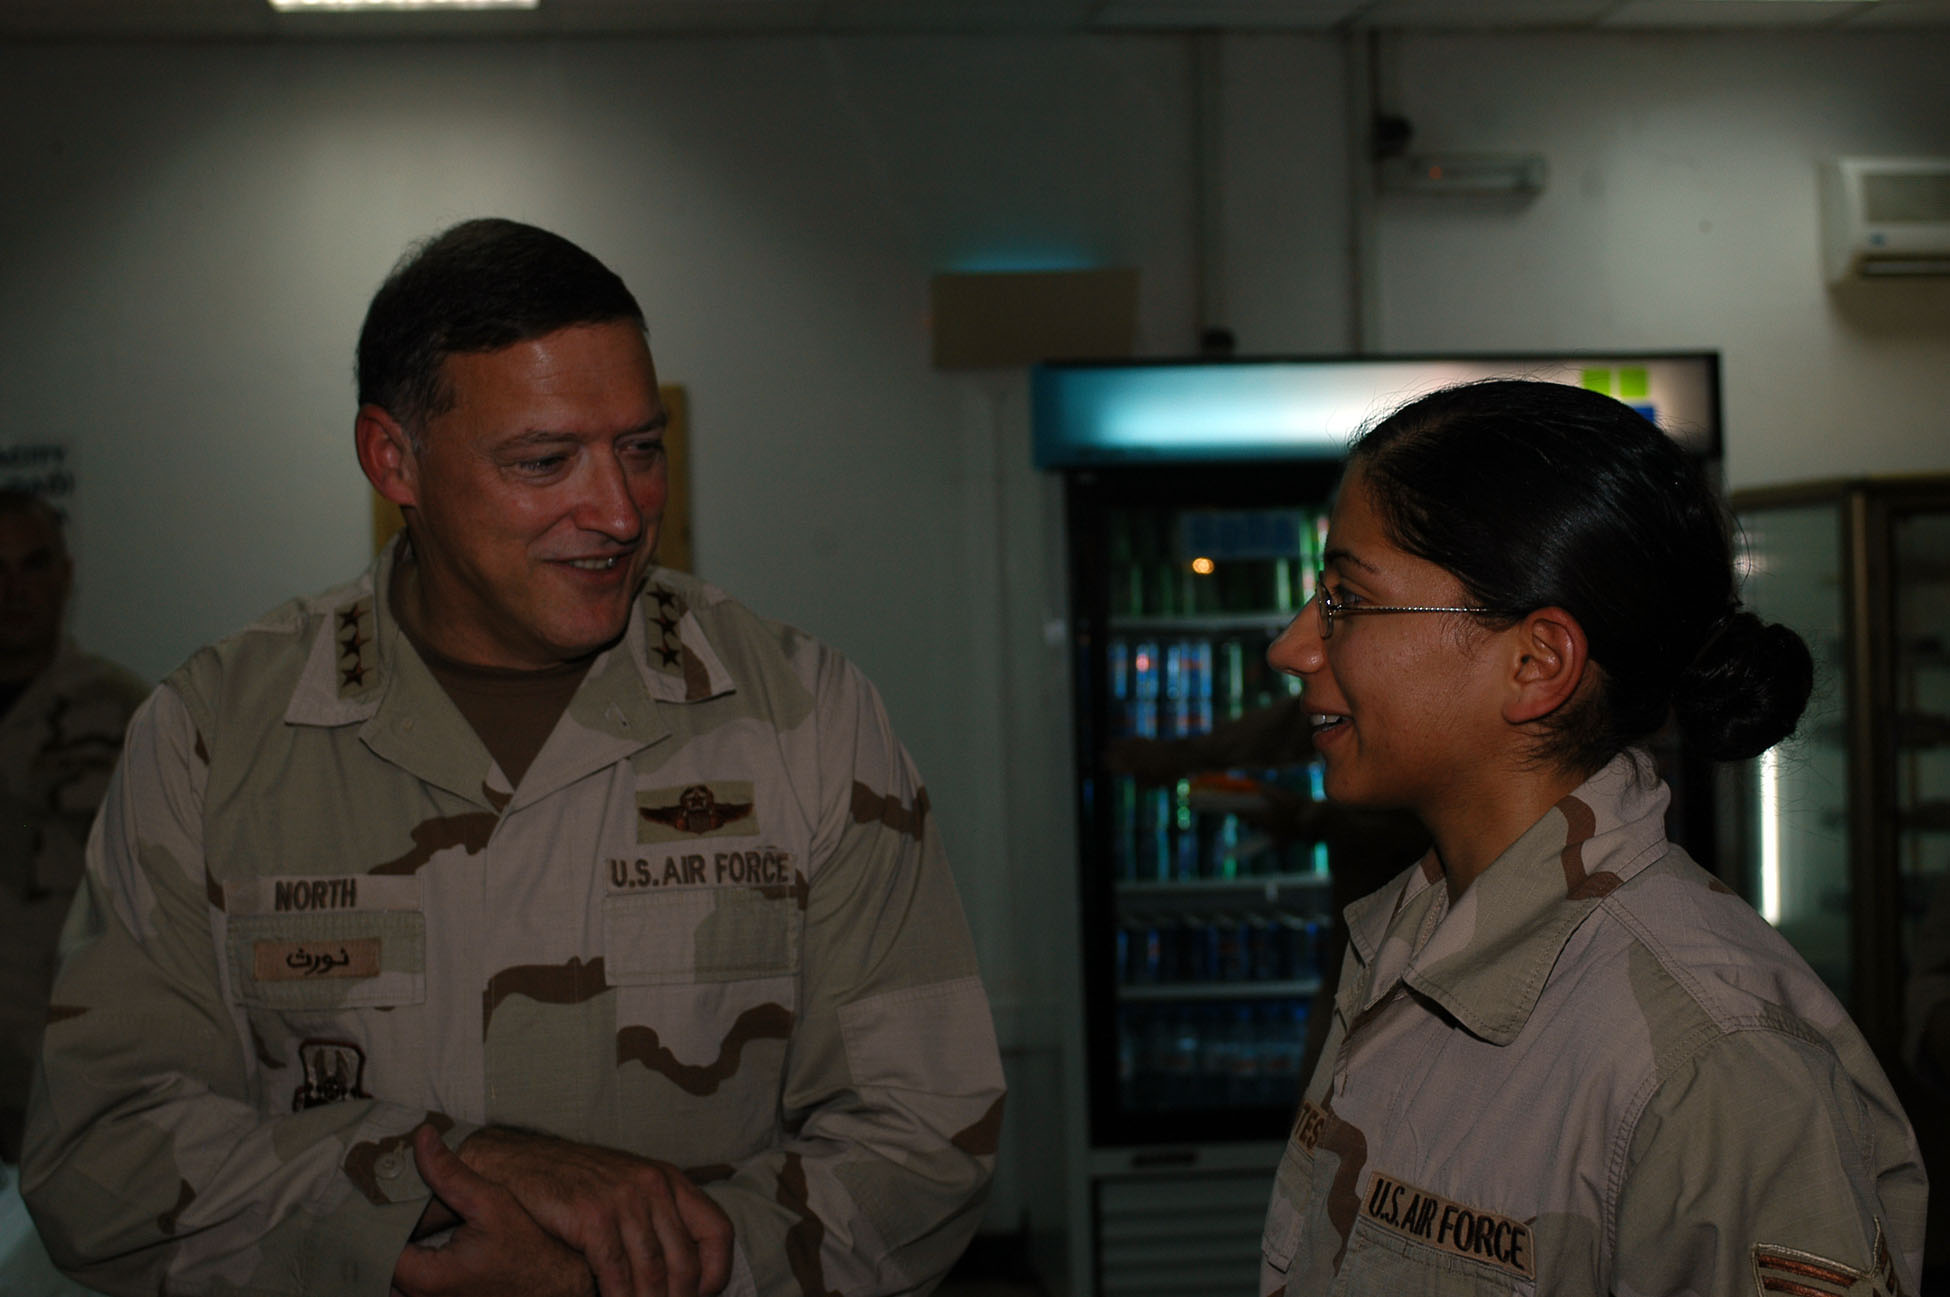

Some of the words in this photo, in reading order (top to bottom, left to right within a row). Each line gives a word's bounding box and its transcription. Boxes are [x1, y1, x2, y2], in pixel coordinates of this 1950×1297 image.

[714, 851, 789, 884] FORCE
[275, 878, 357, 912] NORTH
[1437, 1205, 1526, 1270] FORCE
